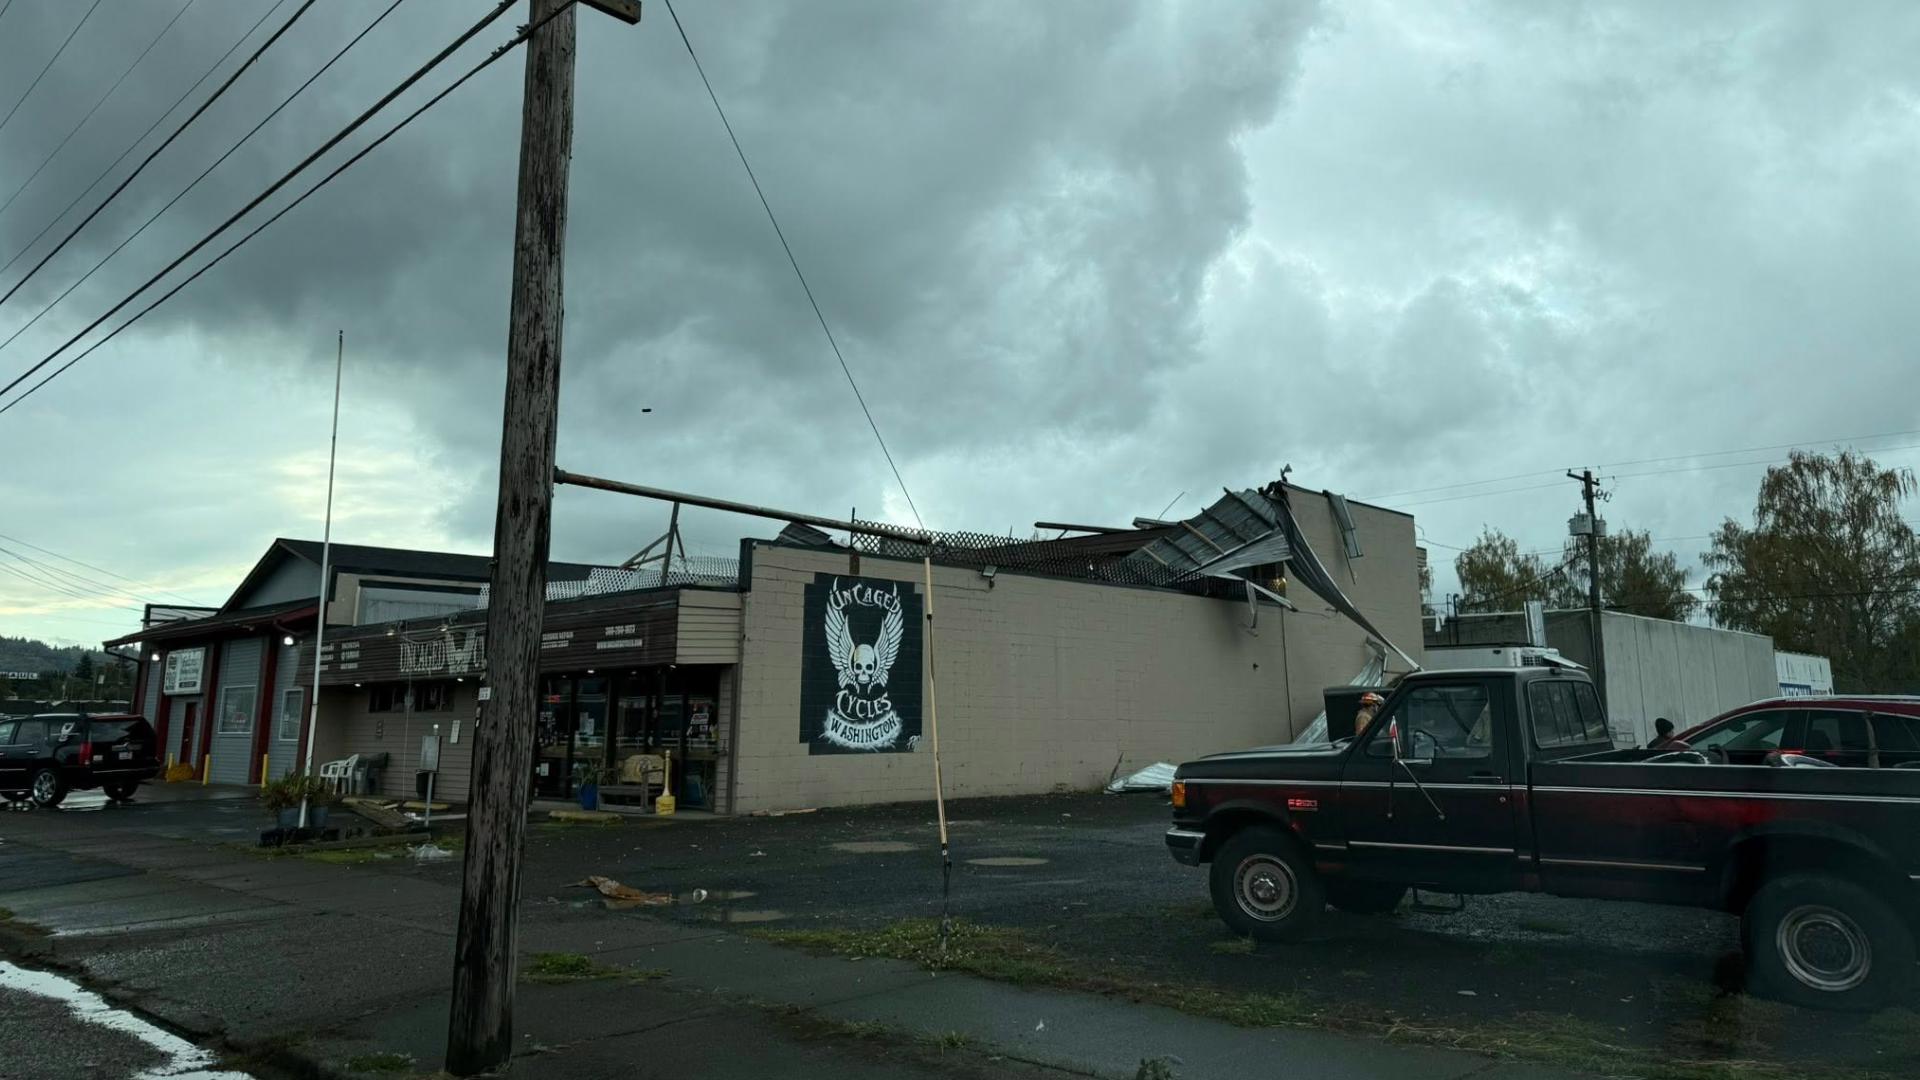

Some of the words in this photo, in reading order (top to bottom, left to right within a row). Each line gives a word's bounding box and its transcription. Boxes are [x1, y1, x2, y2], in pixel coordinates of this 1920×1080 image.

[830, 582, 900, 613] UNCAGED
[400, 640, 446, 675] UNCAGED
[836, 690, 892, 720] CYCLES
[829, 715, 897, 744] WASHINGTON
